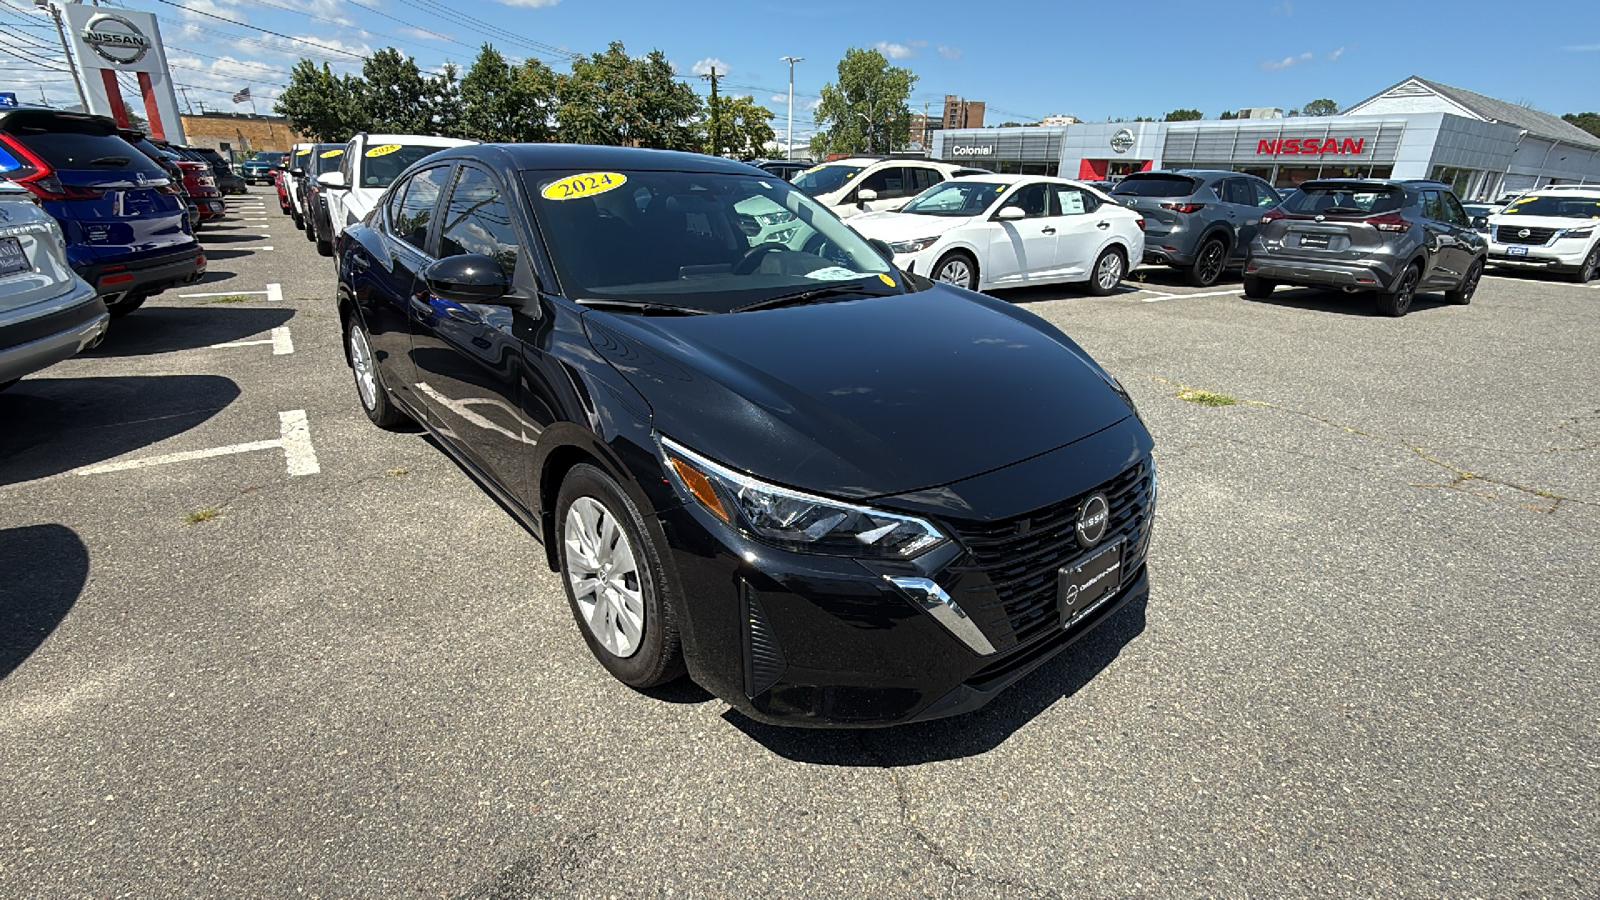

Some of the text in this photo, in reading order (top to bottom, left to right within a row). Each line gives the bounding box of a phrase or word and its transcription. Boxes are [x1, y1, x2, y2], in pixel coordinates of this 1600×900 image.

[87, 33, 144, 46] NISSAN
[953, 144, 992, 155] Colonial
[1256, 138, 1364, 154] NISSAN
[558, 174, 612, 197] 2024
